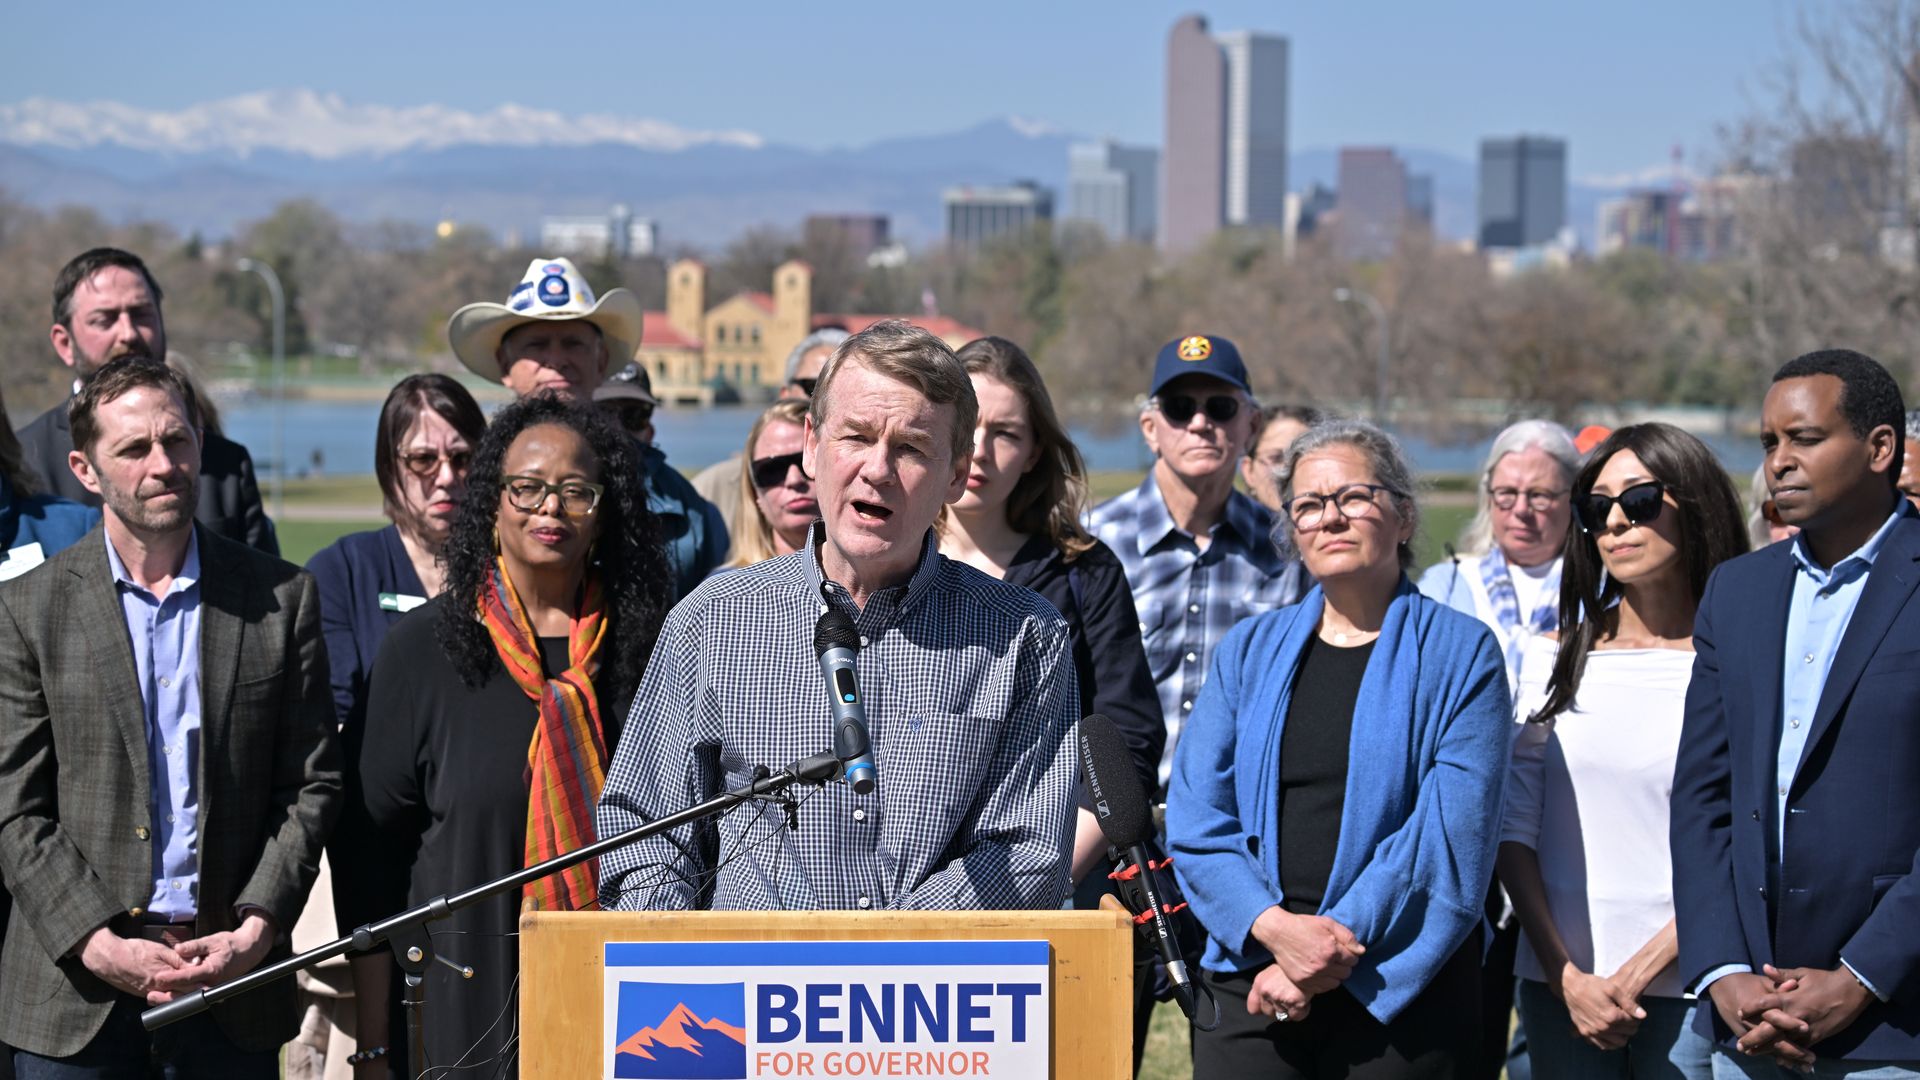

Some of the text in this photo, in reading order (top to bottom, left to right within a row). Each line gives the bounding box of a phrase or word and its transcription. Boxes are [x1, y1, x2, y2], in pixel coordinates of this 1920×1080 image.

[1081, 735, 1102, 798] SENNHEISER
[756, 983, 1042, 1043] BENNET
[756, 1051, 990, 1076] FOR GOVERNOR
